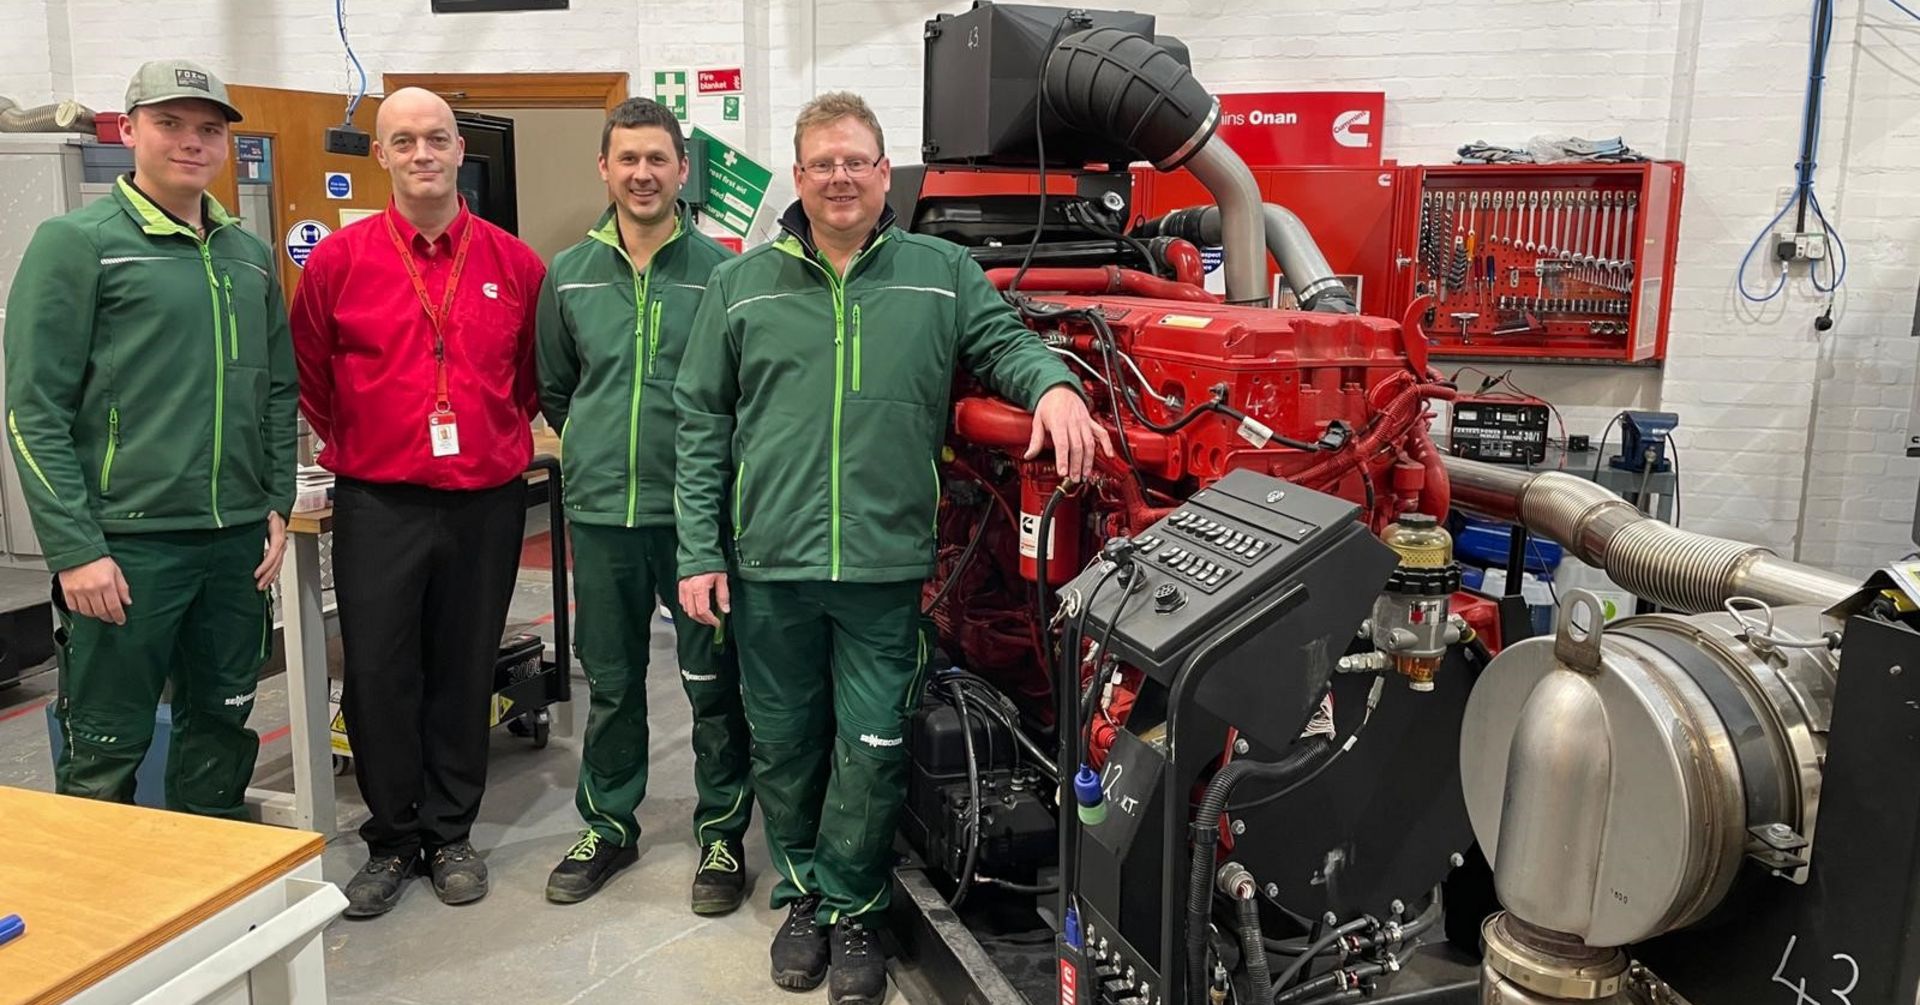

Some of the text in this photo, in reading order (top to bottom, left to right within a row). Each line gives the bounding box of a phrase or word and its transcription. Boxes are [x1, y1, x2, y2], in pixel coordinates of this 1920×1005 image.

[699, 73, 714, 81] Fire
[700, 81, 727, 90] blanket
[1249, 110, 1297, 125] Onan
